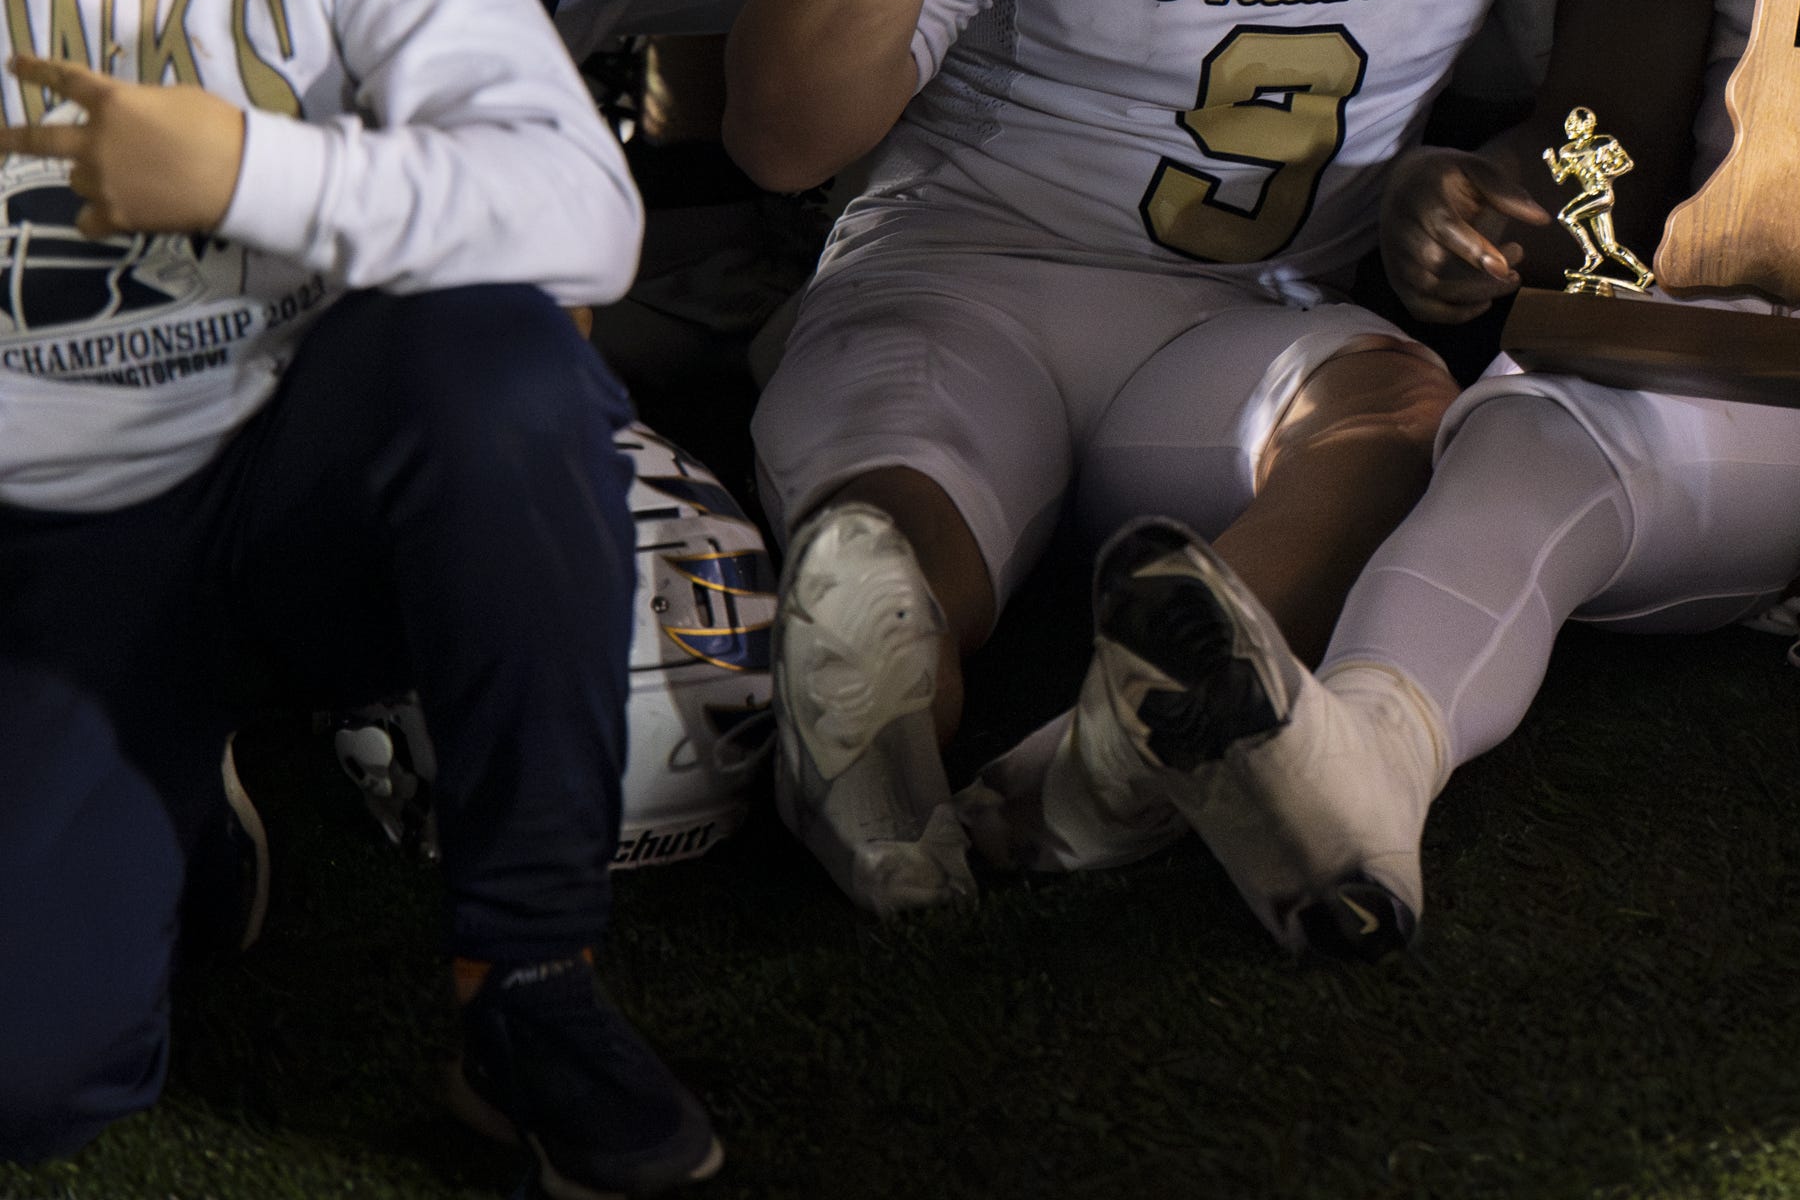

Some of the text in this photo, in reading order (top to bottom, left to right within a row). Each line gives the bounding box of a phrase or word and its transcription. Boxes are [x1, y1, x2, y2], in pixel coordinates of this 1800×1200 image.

[1138, 22, 1369, 265] 9
[4, 306, 254, 376] CHAMPIONSHIP
[615, 821, 716, 862] chutt
